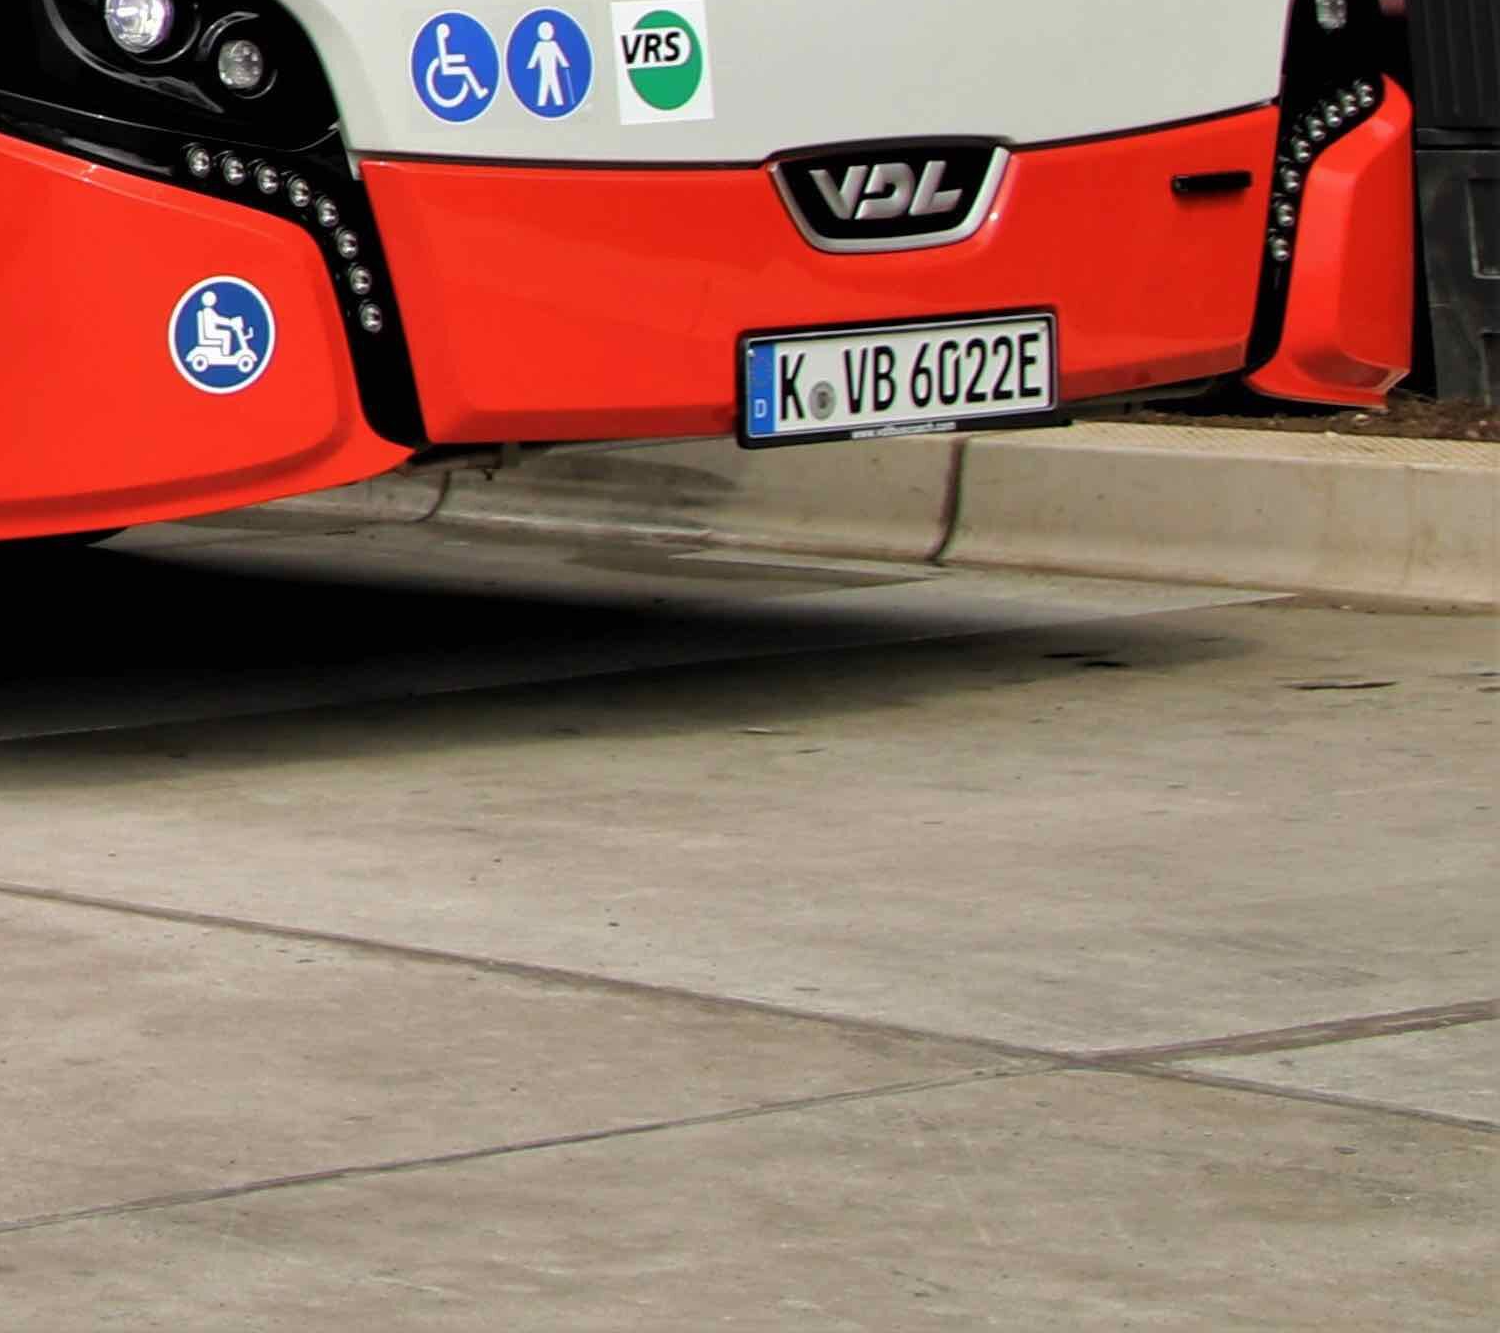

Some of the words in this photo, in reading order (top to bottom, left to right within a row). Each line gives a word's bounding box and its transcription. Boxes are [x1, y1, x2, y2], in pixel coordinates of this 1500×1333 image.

[620, 31, 682, 65] VRS
[808, 159, 964, 221] VDL
[779, 352, 807, 421] K
[844, 344, 897, 414] VB
[910, 333, 1043, 409] 6022E
[753, 398, 767, 418] D
